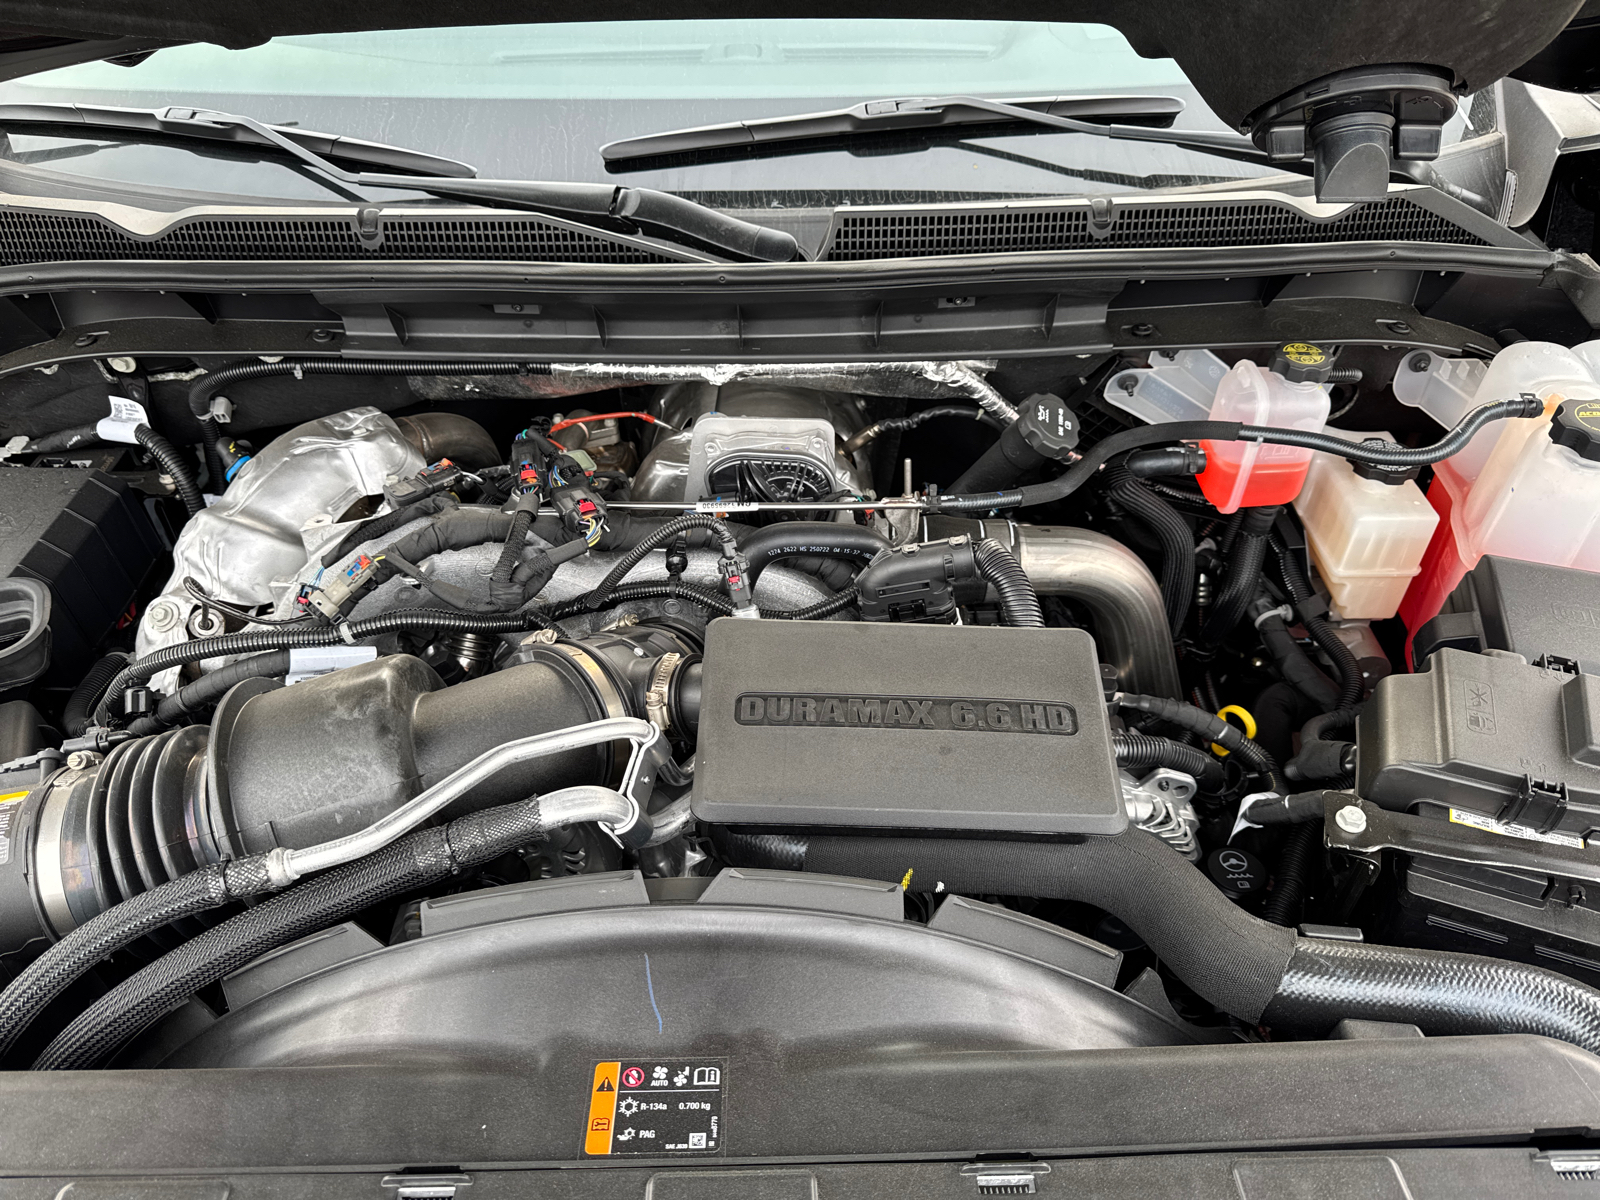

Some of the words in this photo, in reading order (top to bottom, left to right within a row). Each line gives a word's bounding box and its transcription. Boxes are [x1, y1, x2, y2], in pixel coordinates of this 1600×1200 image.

[739, 697, 935, 726] DURAMAX
[950, 702, 1011, 729] 6.6
[1020, 704, 1073, 733] HD
[640, 1102, 667, 1110] R-134a
[679, 1102, 699, 1110] 0.700
[700, 1102, 711, 1111] kg
[639, 1130, 656, 1138] PAG
